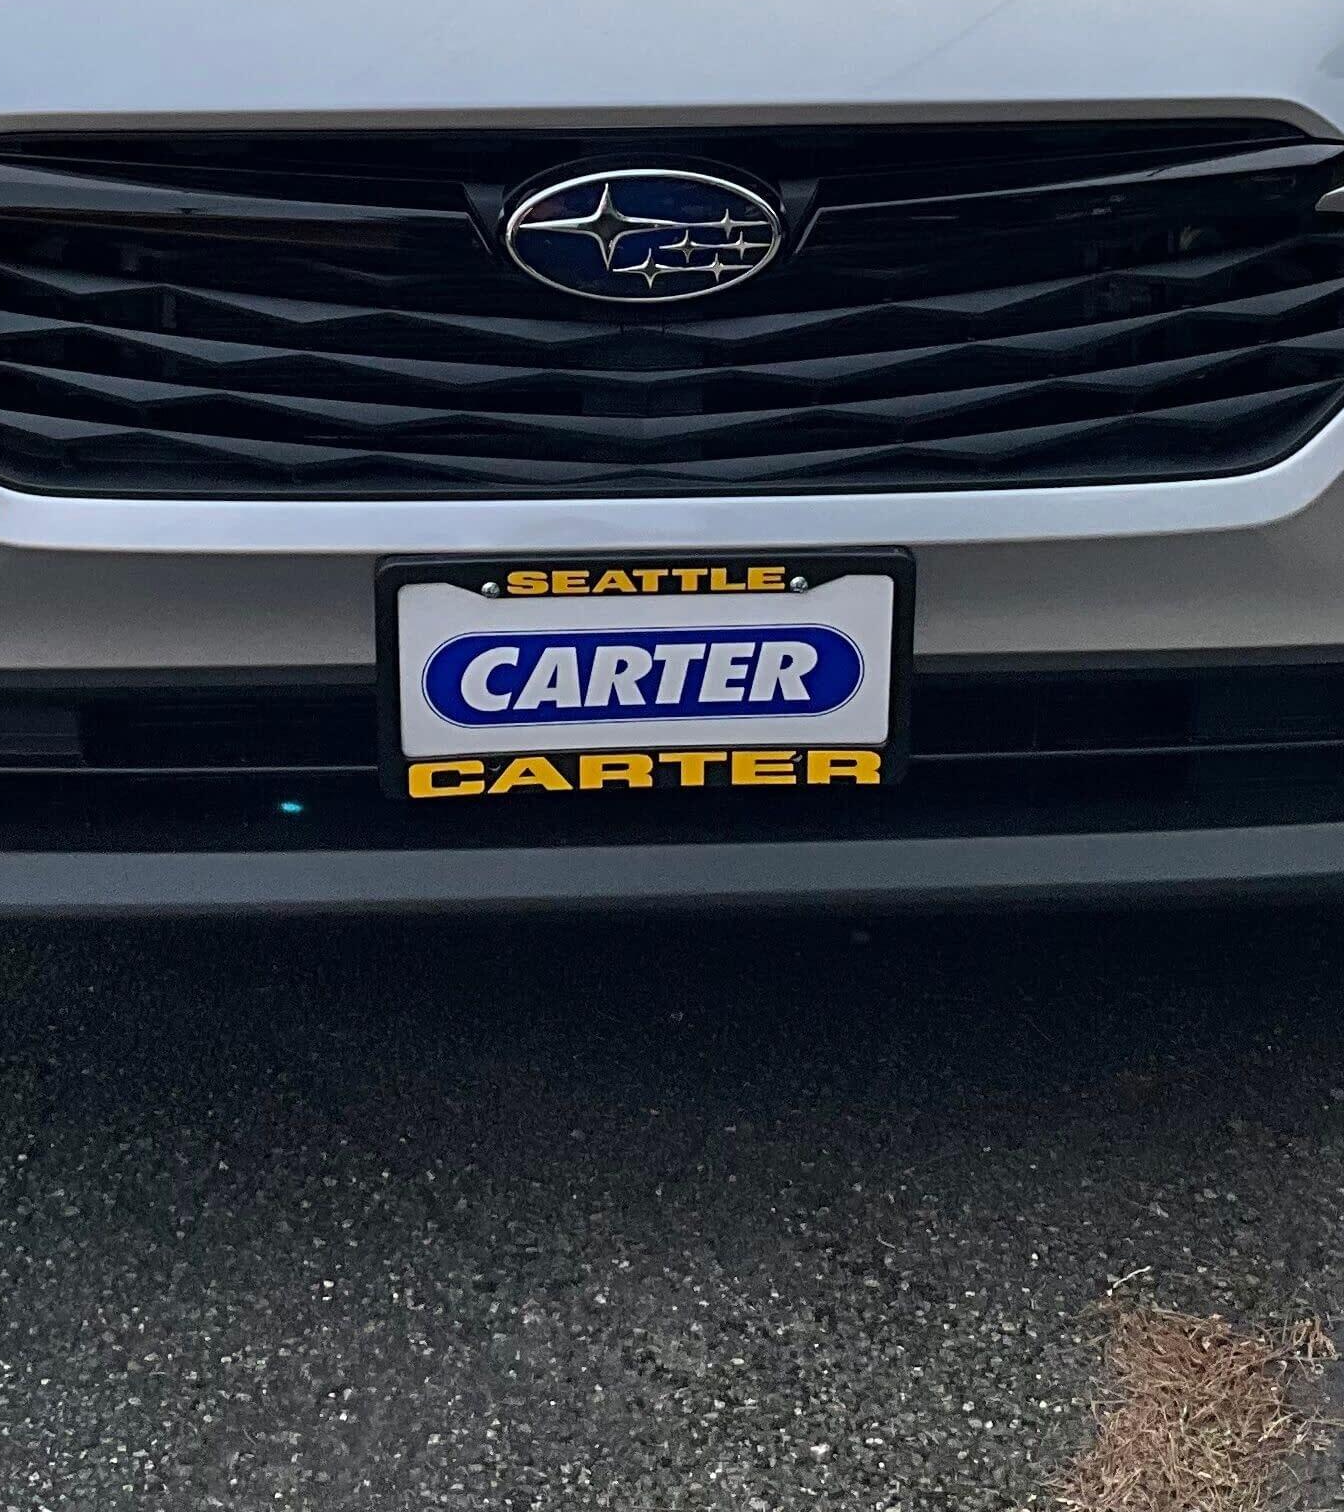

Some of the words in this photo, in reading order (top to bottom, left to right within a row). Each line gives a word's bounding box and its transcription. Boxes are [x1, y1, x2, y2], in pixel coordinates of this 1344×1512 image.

[507, 567, 785, 595] SEATTLE
[460, 640, 818, 712] CARTER
[408, 750, 881, 799] CARTER
